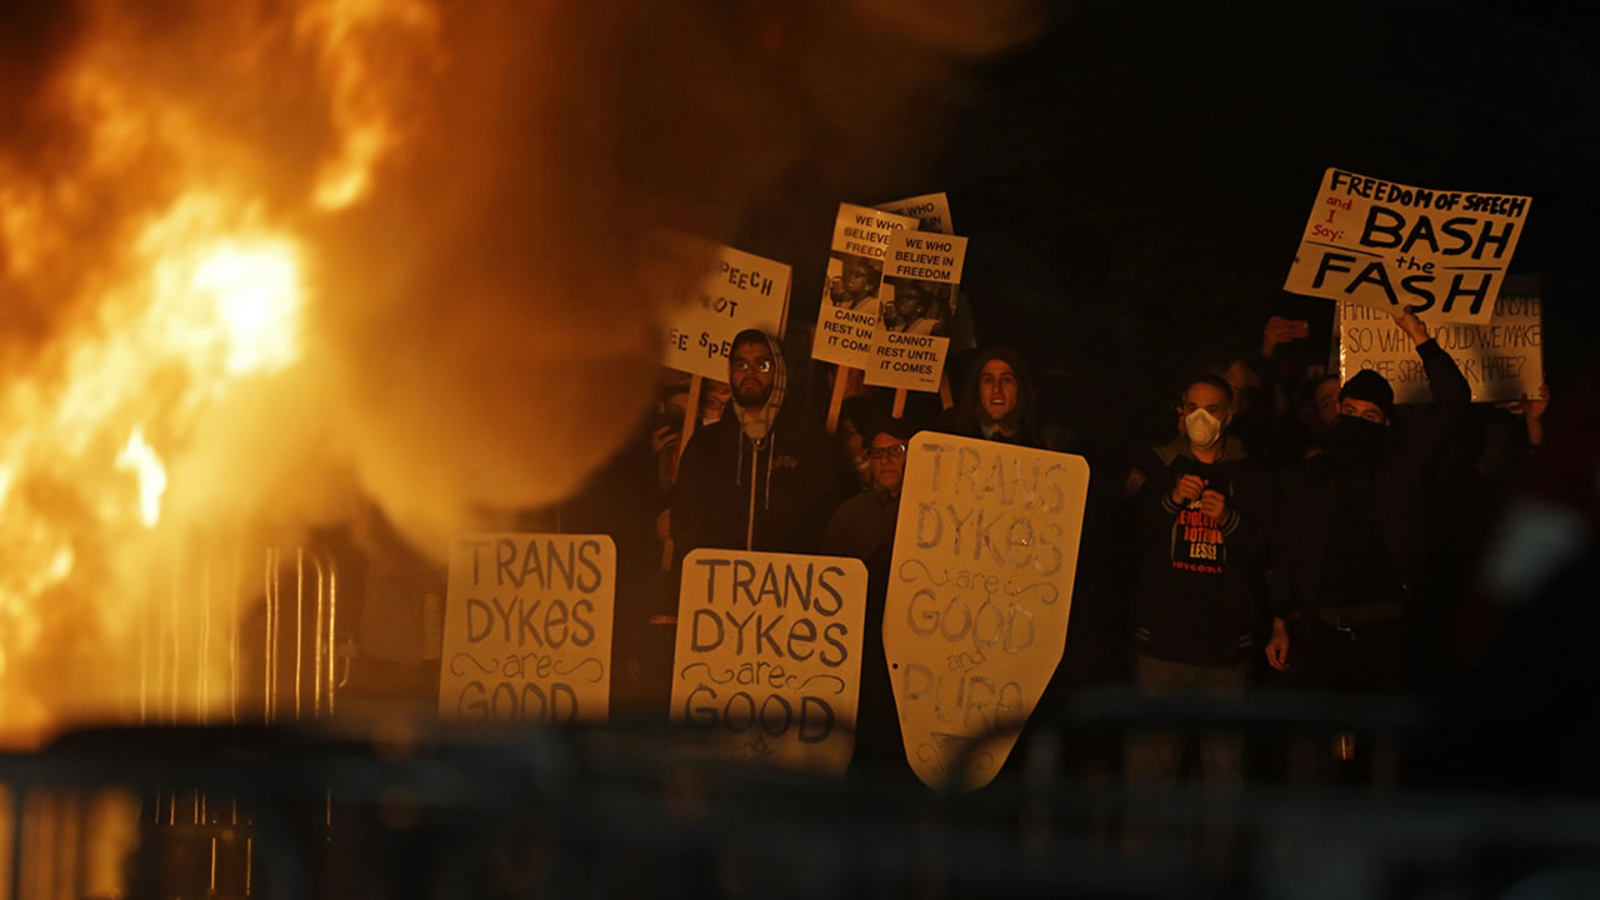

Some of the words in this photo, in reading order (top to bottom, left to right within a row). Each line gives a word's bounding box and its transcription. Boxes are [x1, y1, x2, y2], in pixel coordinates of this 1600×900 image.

[1331, 170, 1433, 209] FREEDOM
[1434, 193, 1461, 211] OF
[1462, 194, 1527, 217] SPEECH
[908, 202, 934, 216] WHO
[1326, 196, 1353, 210] and
[855, 215, 874, 227] WE
[876, 218, 904, 231] WHO
[1326, 209, 1336, 223] I
[1360, 205, 1514, 259] BASH
[846, 242, 886, 257] FREED
[905, 238, 923, 249] WE
[926, 240, 952, 252] WHO
[895, 251, 940, 266] BELIEVE
[942, 257, 954, 267] IN
[1396, 256, 1435, 274] the
[721, 261, 772, 296] PEECH
[897, 265, 951, 280] FREEDOM
[1312, 252, 1492, 314] FASH
[835, 310, 875, 327] CANNO
[824, 321, 853, 335] REST
[828, 336, 839, 346] IT
[841, 339, 871, 353] COM
[888, 334, 934, 347] CANNOT
[1348, 327, 1373, 353] SO
[1476, 325, 1501, 349] WE
[1503, 324, 1540, 347] MAKE
[877, 346, 906, 358] REST
[908, 350, 938, 361] UNTIL
[880, 361, 891, 369] IT
[893, 361, 933, 375] COMES
[920, 443, 1066, 514] TRANS
[1190, 543, 1217, 560] LESS!
[460, 538, 602, 594] TRANS
[695, 559, 846, 617] TRANS
[955, 568, 998, 595] are
[907, 588, 1035, 654] GOOD
[502, 652, 553, 679] are
[736, 661, 785, 688] are
[458, 681, 578, 724] GOOD
[686, 683, 835, 743] GOOD
